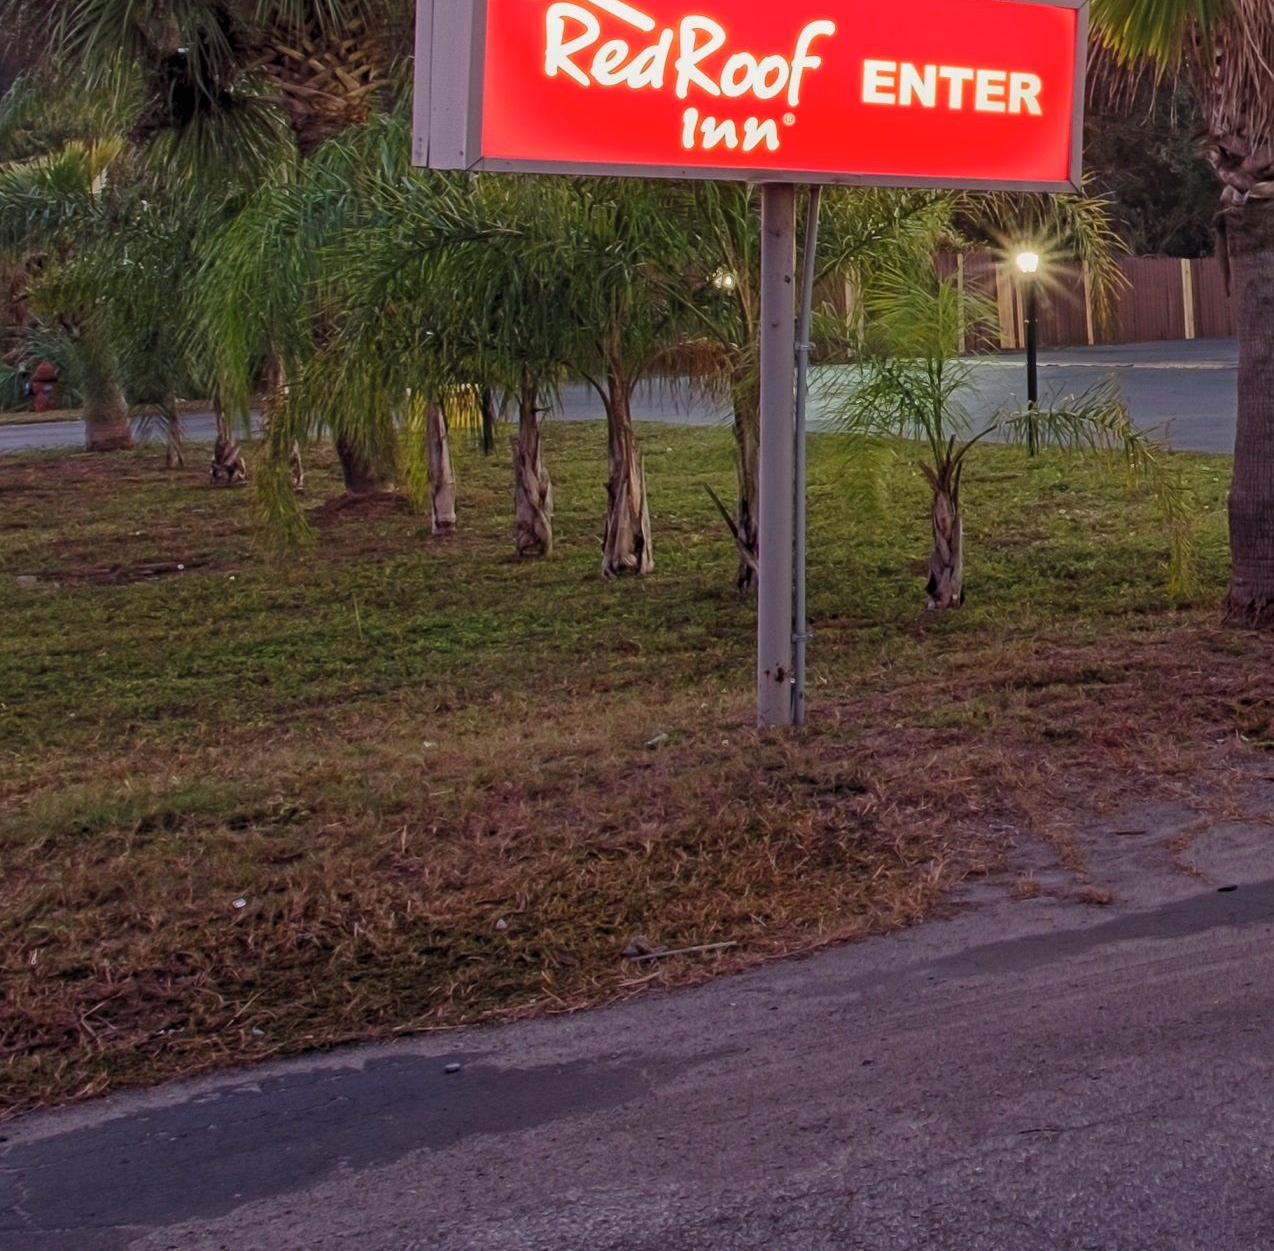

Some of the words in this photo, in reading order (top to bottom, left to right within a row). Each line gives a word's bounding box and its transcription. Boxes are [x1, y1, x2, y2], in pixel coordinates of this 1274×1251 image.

[543, 2, 674, 89] Red
[673, 15, 836, 108] Roof
[861, 59, 1042, 115] ENTER
